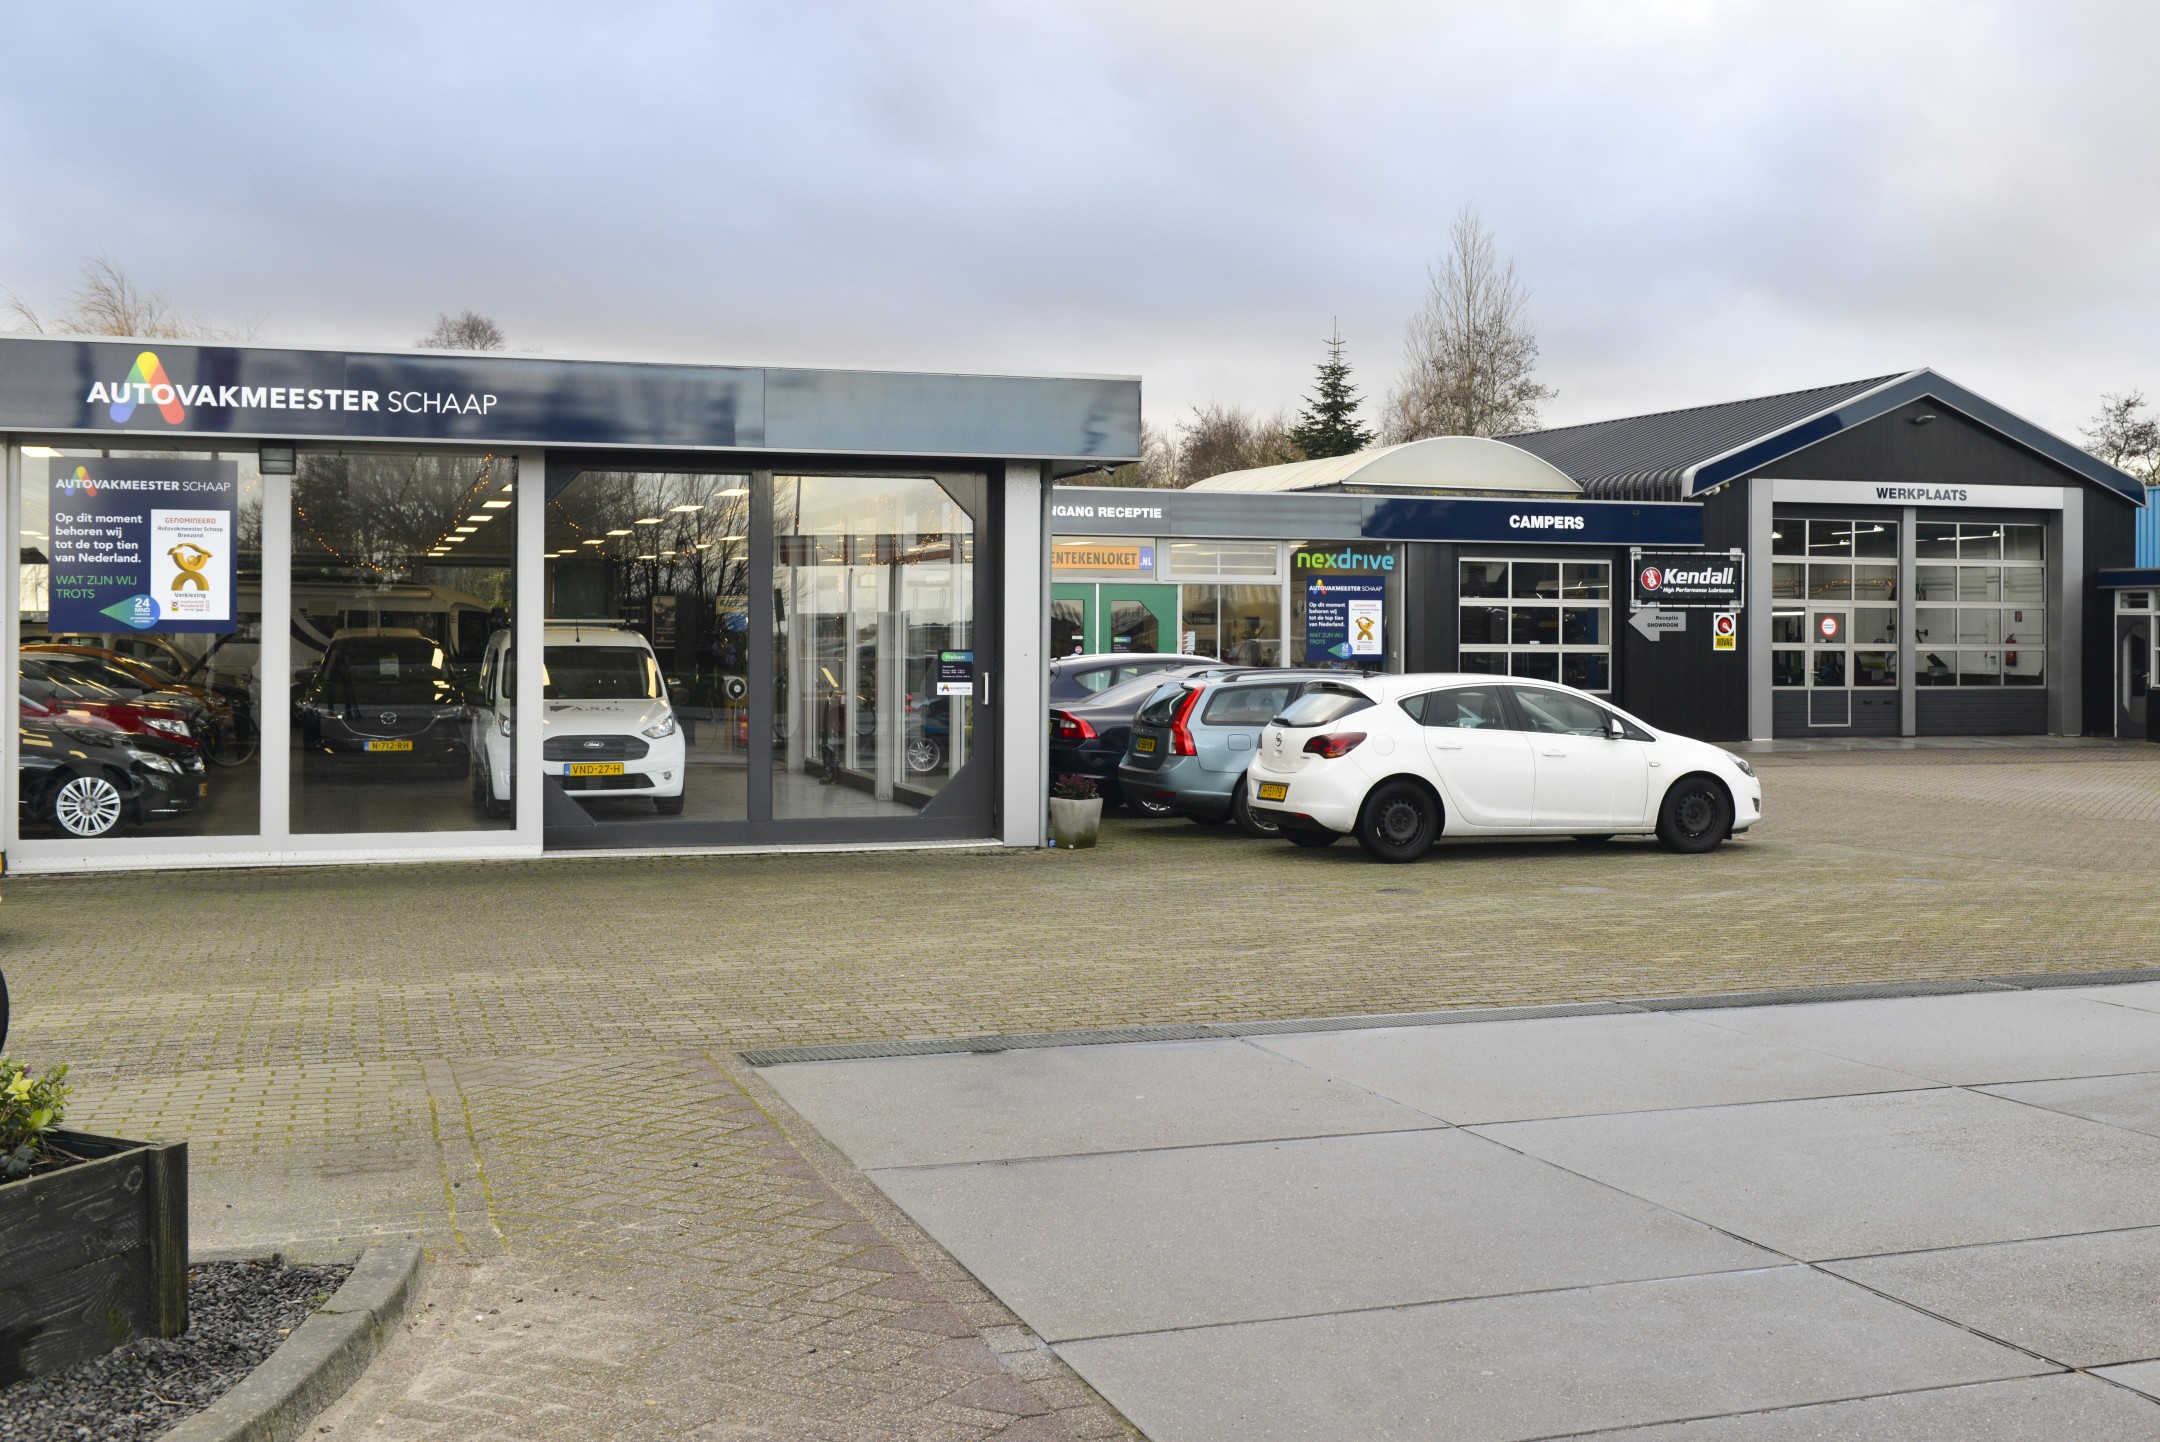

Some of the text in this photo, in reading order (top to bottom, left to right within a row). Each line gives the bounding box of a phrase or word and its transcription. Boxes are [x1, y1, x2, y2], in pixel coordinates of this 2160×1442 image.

[87, 382, 498, 415] AUTOVAKMEESTER SCHAAP
[55, 479, 231, 492] AUTOVAKMEESTER SCHAAP
[1876, 487, 1967, 501] WERKPLAATS
[55, 513, 143, 524] Op dit moment
[1098, 507, 1162, 519] RECEPTIE
[1509, 515, 1585, 529] CAMPERS
[55, 526, 122, 539] behoren wij
[55, 539, 139, 552] tot de top tien
[55, 553, 142, 563] van Nederland.
[1297, 547, 1395, 571] nexdrive
[56, 575, 137, 586] WAT ZIJN WIJ
[1663, 567, 1734, 585] Kendall
[56, 589, 95, 599] TROTS
[135, 598, 151, 608] 24
[1716, 638, 1733, 647] BOVAG
[572, 765, 620, 774] VND-27-H
